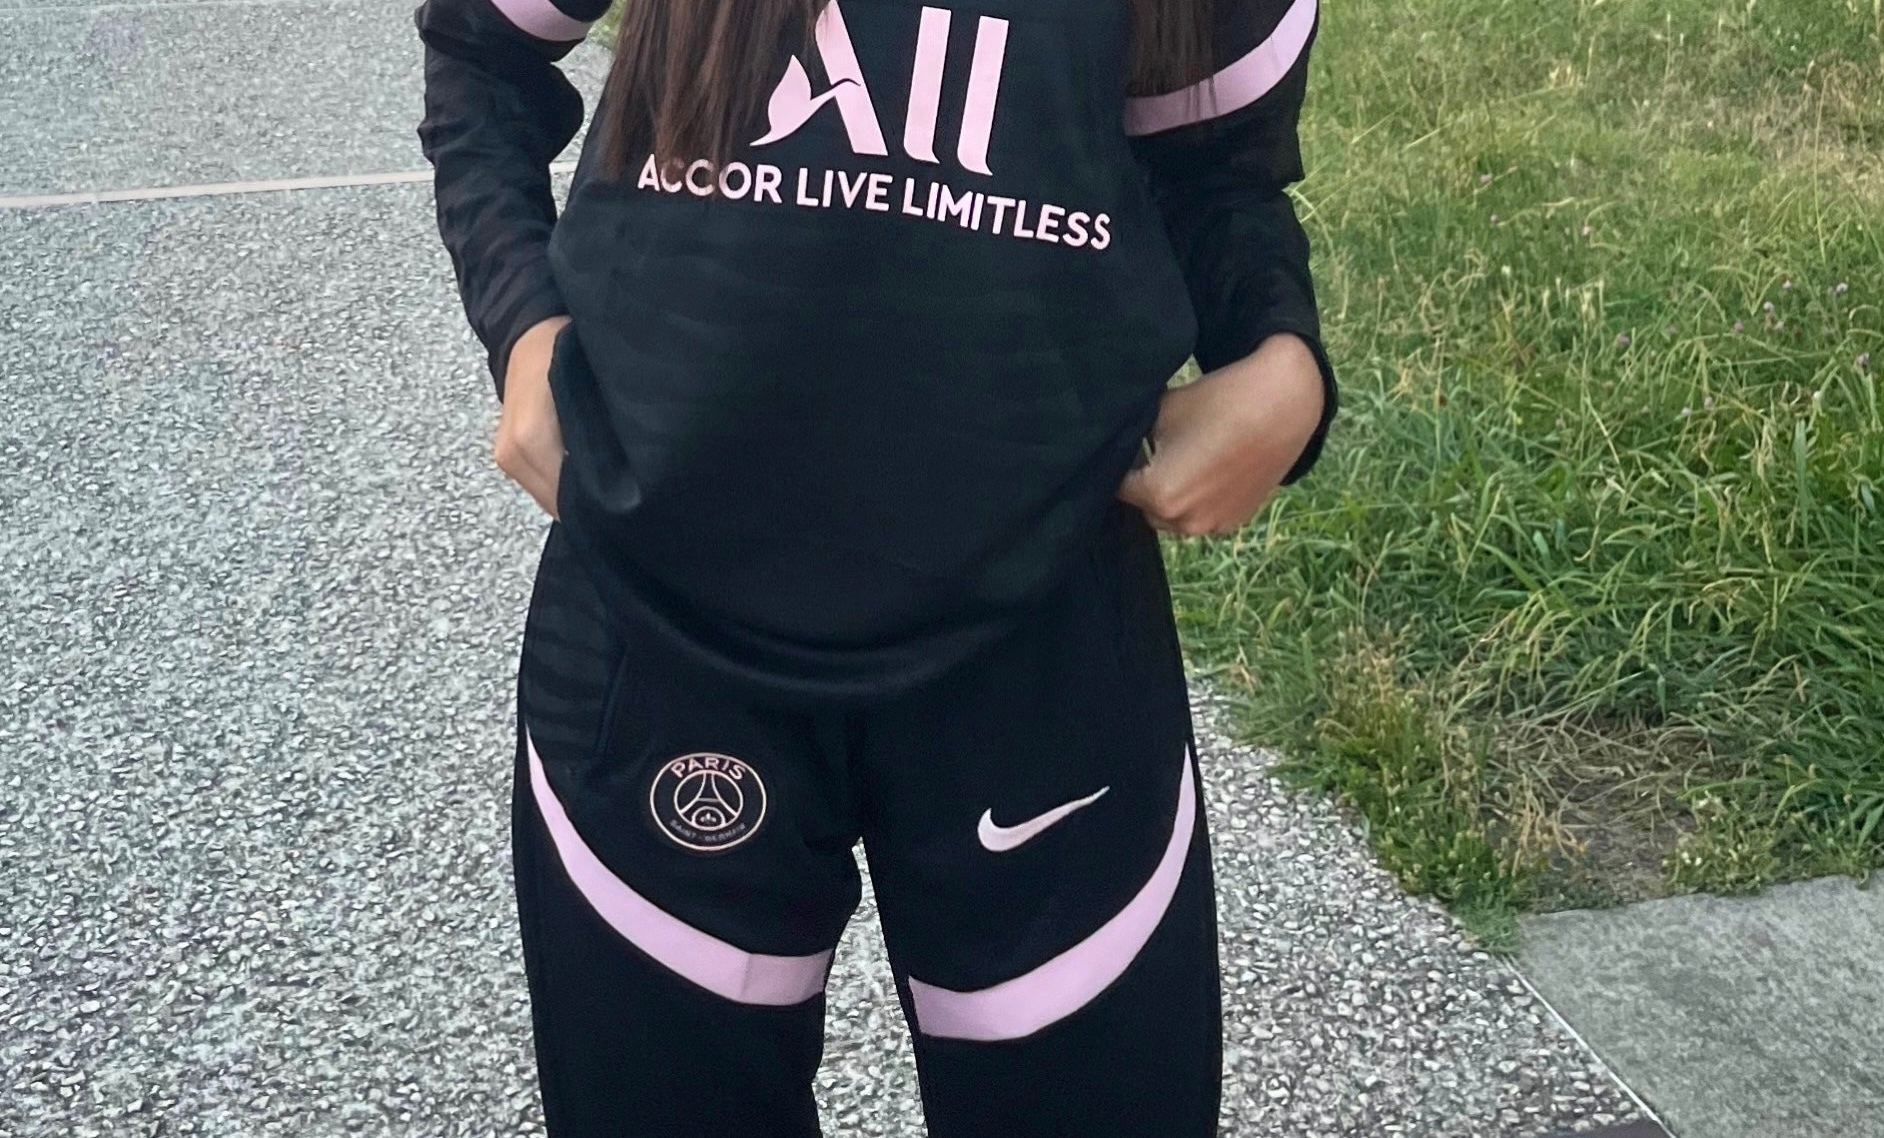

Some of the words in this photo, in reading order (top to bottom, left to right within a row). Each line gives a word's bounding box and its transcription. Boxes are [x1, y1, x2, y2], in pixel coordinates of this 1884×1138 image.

[637, 153, 782, 204] ACCOR
[796, 167, 894, 212] LIVE
[901, 176, 1112, 251] LIMITLESS
[670, 756, 747, 781] PARIS
